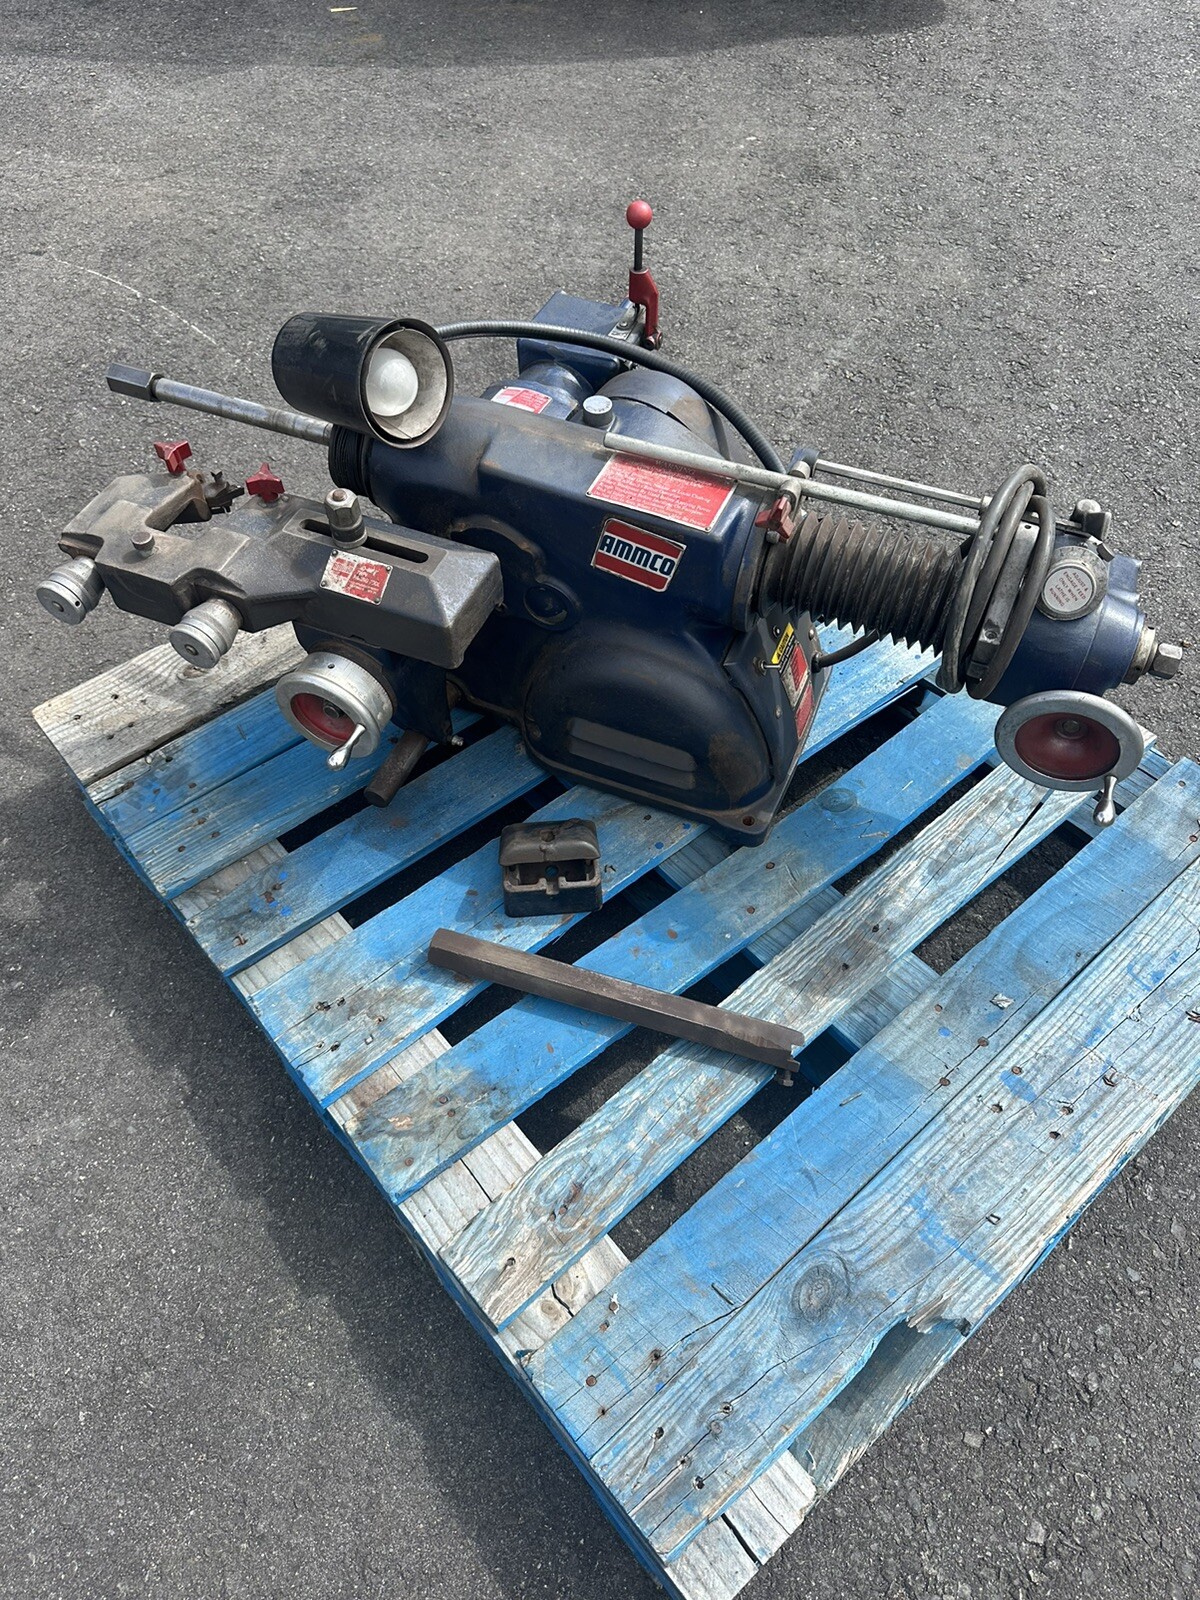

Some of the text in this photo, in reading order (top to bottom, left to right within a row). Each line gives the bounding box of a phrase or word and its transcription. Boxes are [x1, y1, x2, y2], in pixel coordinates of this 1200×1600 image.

[655, 460, 696, 475] WARNING
[599, 534, 676, 577] AMMCO
[1063, 571, 1086, 600] ENGAGE FEED
[1073, 572, 1086, 588] ADJUST
[1050, 588, 1065, 606] RUNNING
[1055, 585, 1067, 598] LATHE
[1059, 578, 1078, 601] ONLY WHEN
